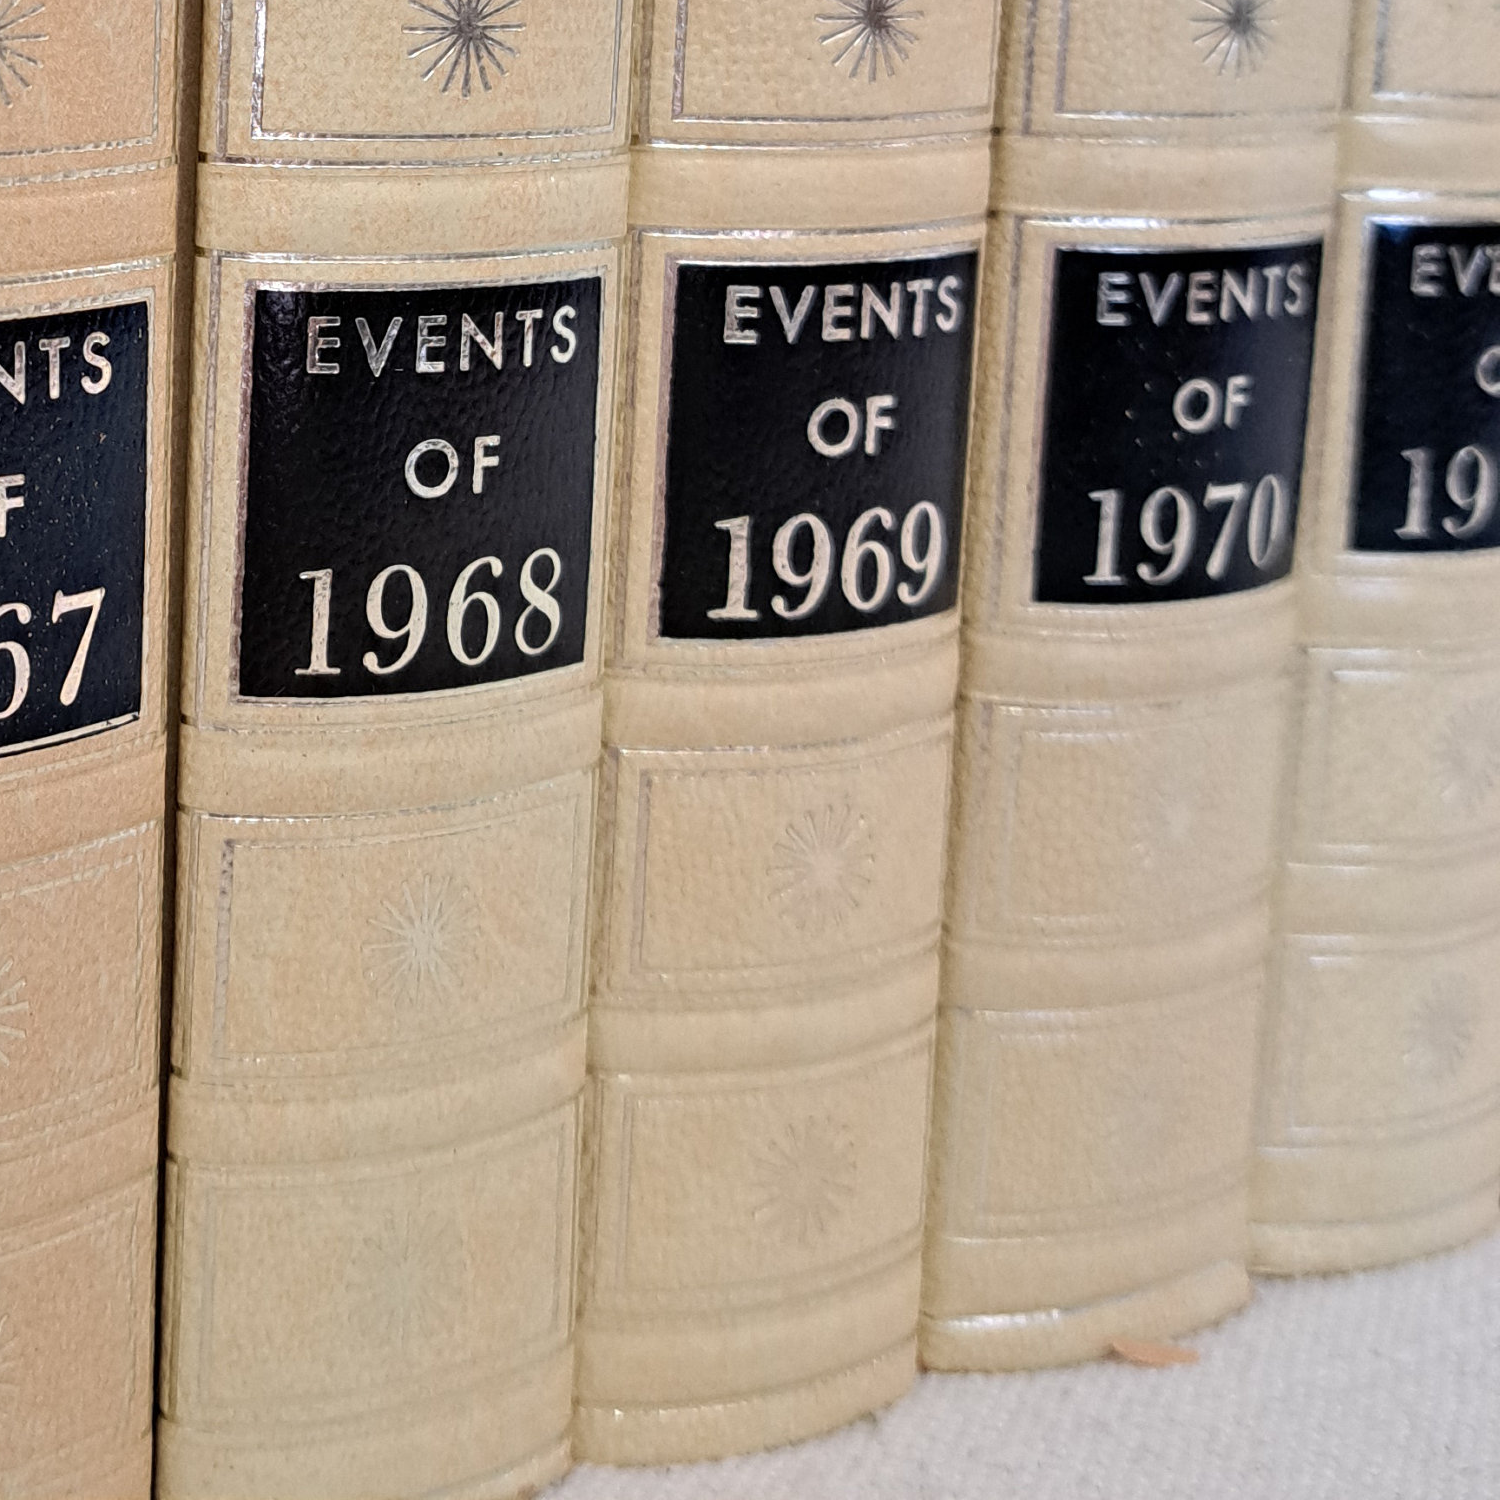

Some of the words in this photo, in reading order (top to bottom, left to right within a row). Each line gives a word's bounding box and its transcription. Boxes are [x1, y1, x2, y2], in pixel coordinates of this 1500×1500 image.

[723, 275, 963, 345] EVENTS
[1096, 262, 1308, 327] EVENTS
[306, 305, 576, 377] EVENTS
[807, 395, 897, 458] OF
[1173, 374, 1253, 434] OF
[404, 435, 501, 499] OF
[706, 500, 946, 621] 1969
[1082, 474, 1283, 587] 1970
[294, 547, 562, 675] 1968
